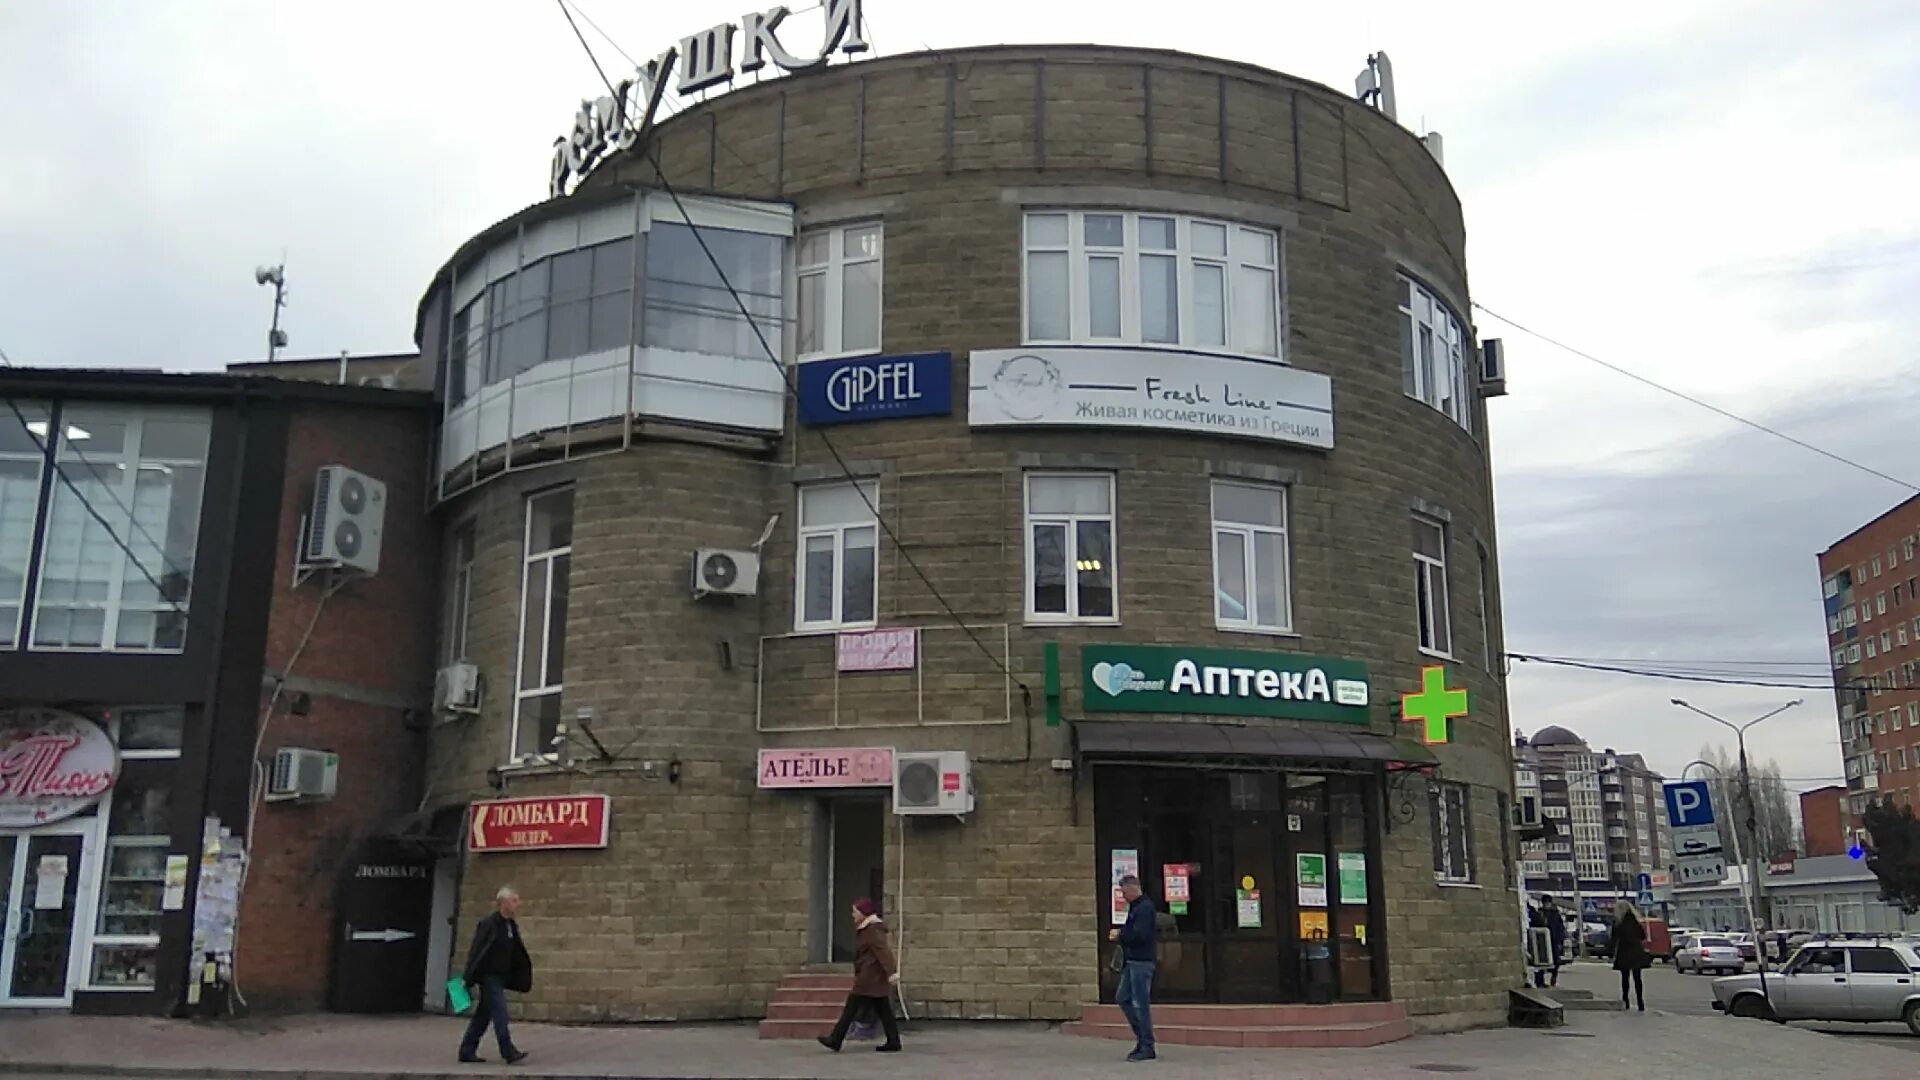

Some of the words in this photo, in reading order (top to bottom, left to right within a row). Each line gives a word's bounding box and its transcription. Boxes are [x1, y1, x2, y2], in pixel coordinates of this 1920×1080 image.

[1145, 377, 1210, 405] Fresh
[1225, 384, 1272, 411] Line
[1075, 401, 1137, 419] Живая
[1143, 408, 1236, 427] косметика
[1240, 416, 1259, 430] из
[1263, 417, 1321, 439] Греции
[764, 758, 850, 777] АТЕЛЬЕ
[490, 801, 588, 827] ЛОМБАРД
[355, 864, 426, 879] ЛОМБАРД
